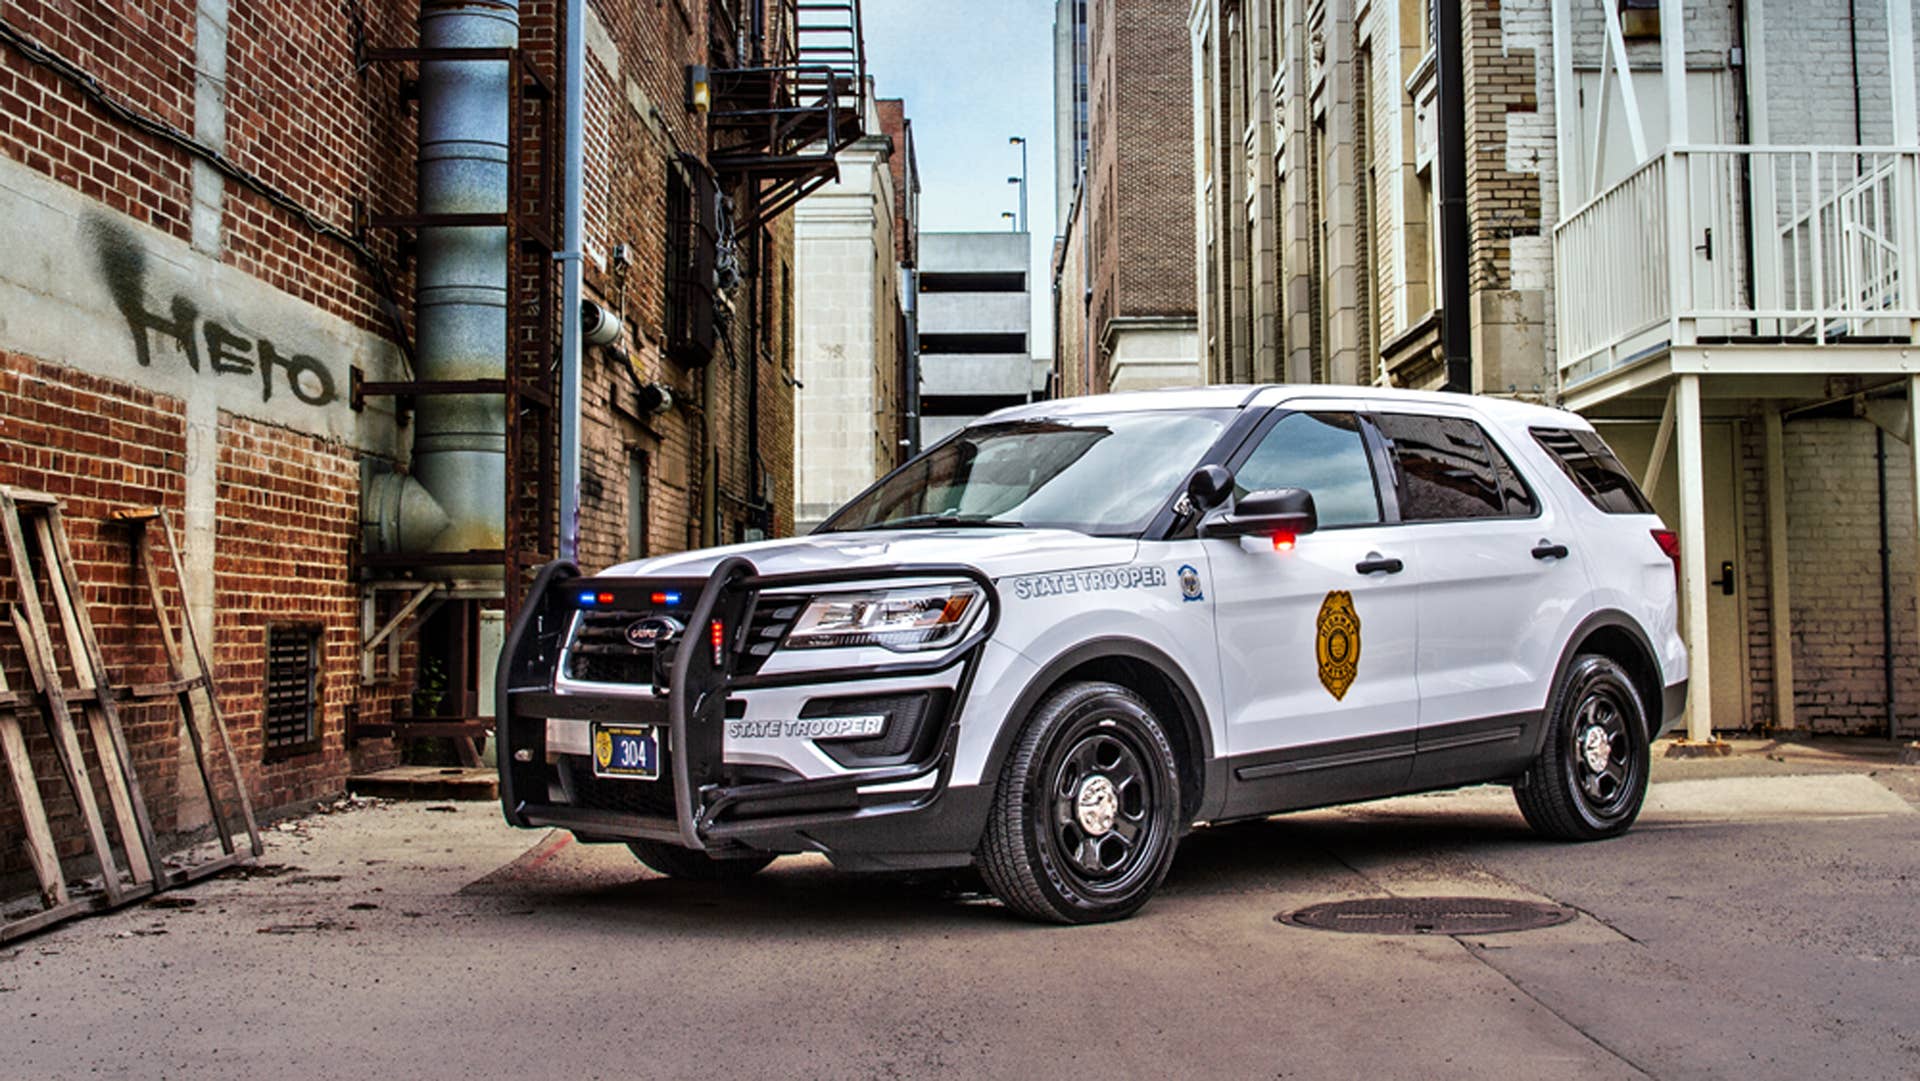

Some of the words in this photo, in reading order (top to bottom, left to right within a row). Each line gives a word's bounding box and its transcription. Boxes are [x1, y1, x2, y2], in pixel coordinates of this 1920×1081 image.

[1014, 572, 1078, 600] STATE
[1078, 566, 1167, 591] TROOPER
[728, 719, 782, 739] STATE
[784, 716, 880, 737] TROOPER
[620, 740, 647, 767] 304
